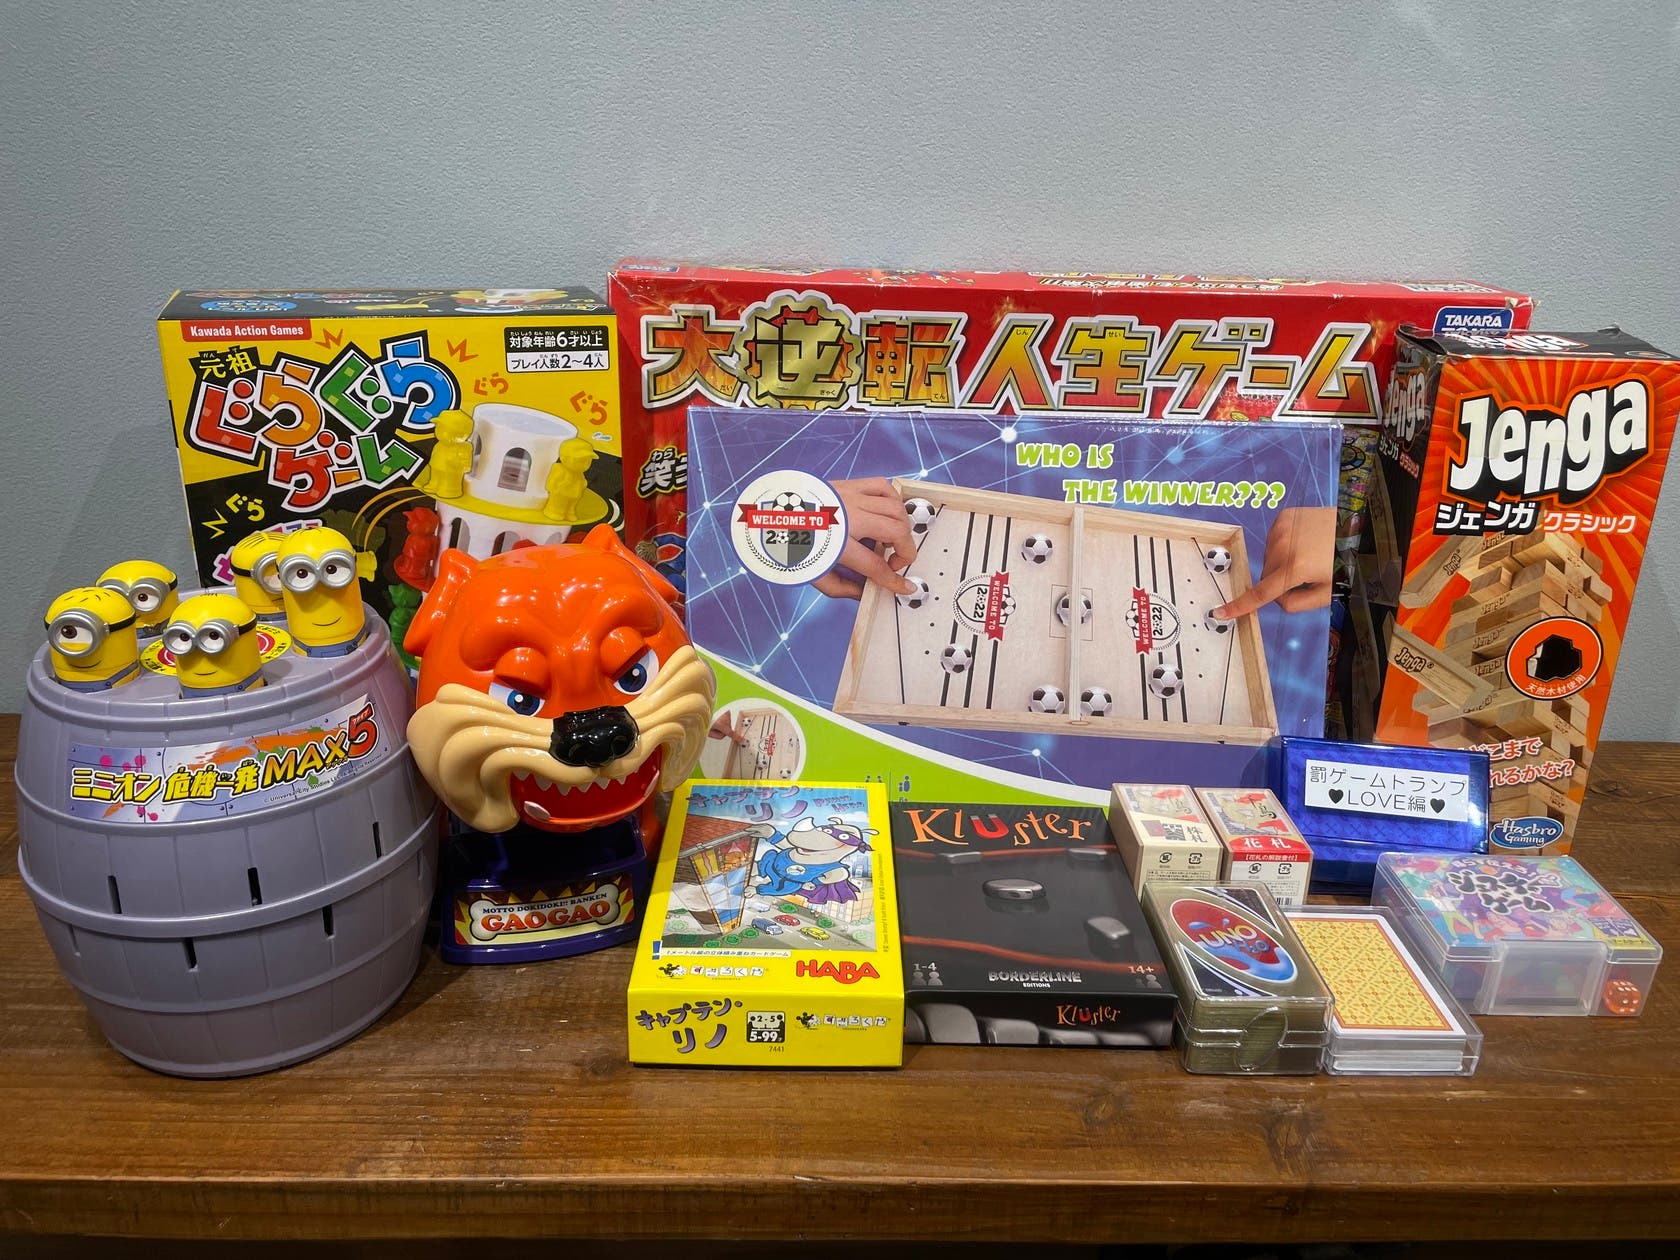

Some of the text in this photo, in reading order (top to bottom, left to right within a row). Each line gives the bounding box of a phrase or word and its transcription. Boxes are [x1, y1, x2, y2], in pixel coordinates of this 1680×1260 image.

[190, 324, 304, 337] Kawada Action Games
[1445, 314, 1502, 327] TAKARA
[509, 331, 604, 348] 対象年齢6才以上
[198, 351, 258, 380] 元祖
[642, 297, 1381, 424] 大逆転人生ゲーム
[474, 372, 509, 396] ぐら
[569, 391, 608, 426] ぐら
[1384, 364, 1427, 442] Jenga
[1450, 379, 1648, 496] Jenga
[1016, 443, 1114, 469] WHO IS
[271, 431, 421, 509] ゲーム
[226, 492, 266, 522] ぐら
[1063, 480, 1285, 509] THE WINNER???
[752, 515, 824, 527] WELCOME TO
[1435, 500, 1637, 534] ジェンガ クラシック
[1443, 552, 1462, 576] Jenga
[987, 579, 1001, 631] WELCOME TO
[1138, 596, 1149, 645] WELCOME TO
[1394, 647, 1427, 673] Jenga
[71, 768, 162, 803] ミニオン
[745, 800, 809, 822] リノ
[1500, 817, 1557, 837] Hasbro
[1504, 831, 1546, 846] Gaming
[1243, 837, 1292, 849] 花札
[480, 899, 611, 932] GAOGAO
[482, 892, 608, 914] MOTTO DOKIDOKI!! BANKEN
[1198, 924, 1258, 948] UNO
[796, 959, 880, 984] HABA
[912, 962, 938, 971] 1-4
[988, 970, 1083, 983] BORDERLINE
[1127, 965, 1155, 974] 14+
[672, 1023, 728, 1054] リノ
[749, 1030, 778, 1042] 5-99
